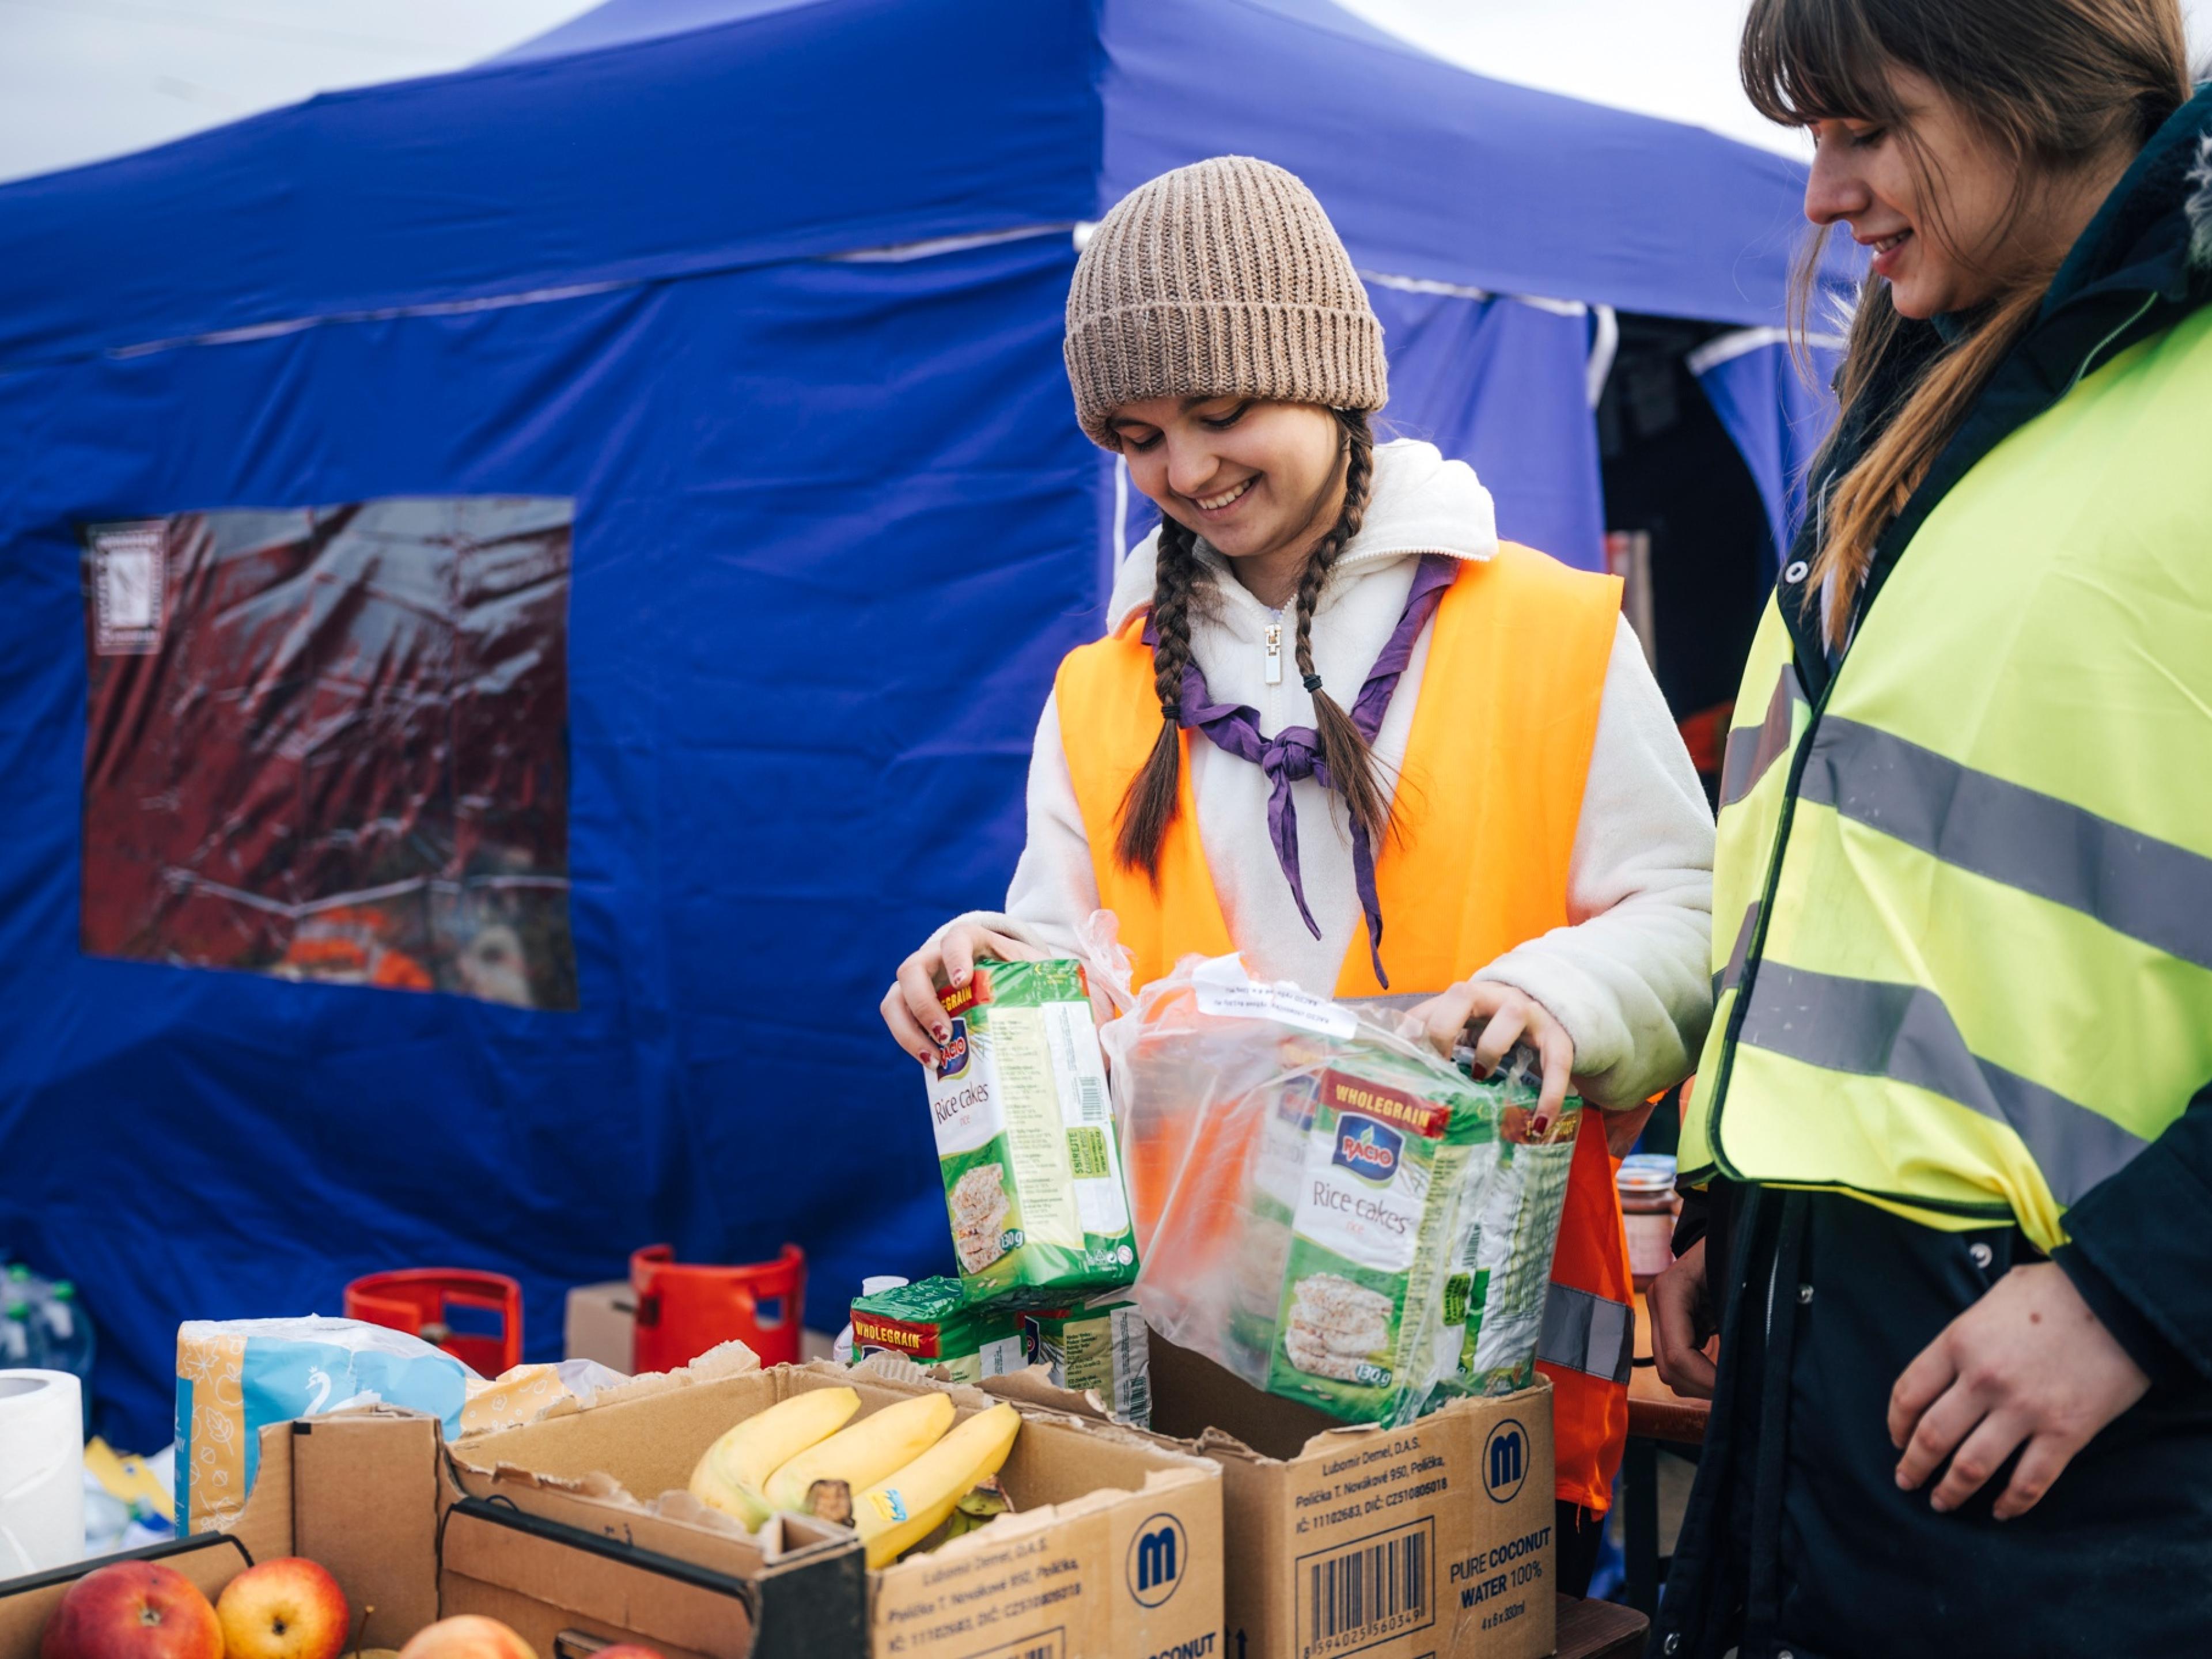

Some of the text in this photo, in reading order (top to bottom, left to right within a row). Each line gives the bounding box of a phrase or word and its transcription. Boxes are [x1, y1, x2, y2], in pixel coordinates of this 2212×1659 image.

[935, 1096, 959, 1125] Rice
[960, 1081, 989, 1108] cakes
[1336, 1084, 1431, 1127] WHOLEGRAIN
[1342, 1136, 1393, 1167] RACIO
[1313, 1180, 1410, 1234] Rice cakes
[1346, 1221, 1365, 1234] rice
[855, 1320, 920, 1349] WHOLEGRAIN
[1450, 1527, 1552, 1584] PURE COCONUT
[1461, 1560, 1543, 1608] WATER 100%
[1149, 1631, 1217, 1659] ONUT
